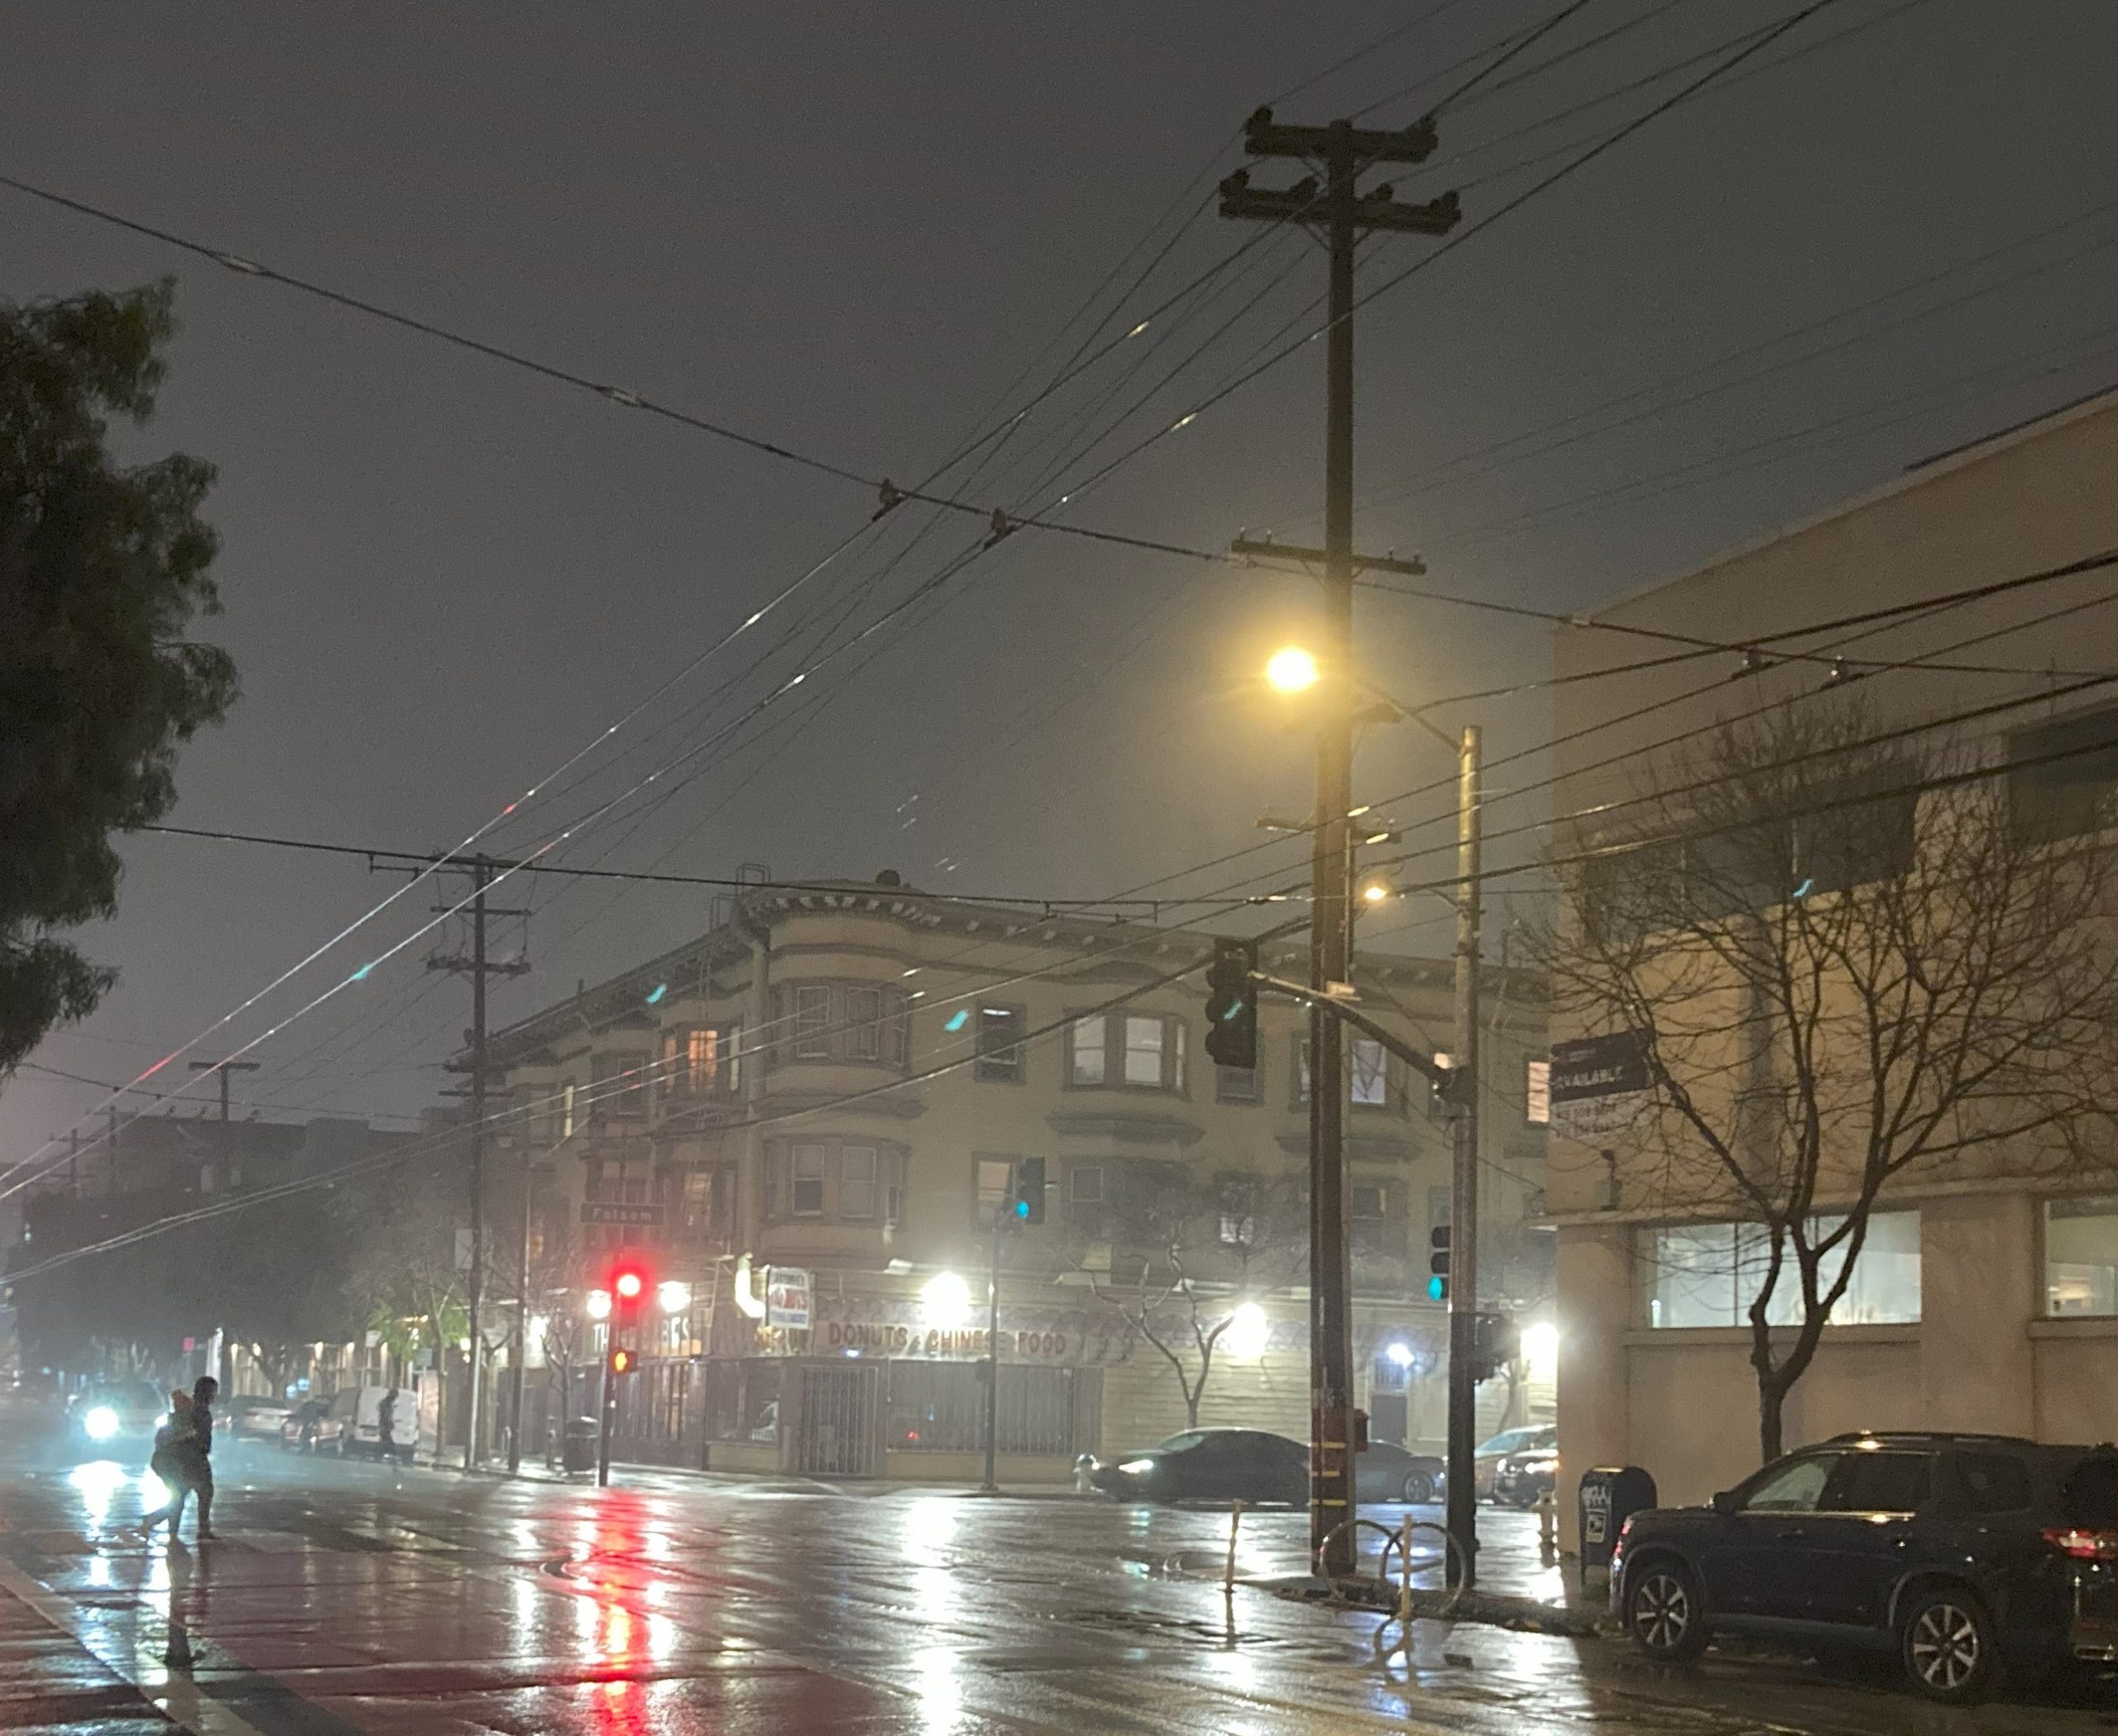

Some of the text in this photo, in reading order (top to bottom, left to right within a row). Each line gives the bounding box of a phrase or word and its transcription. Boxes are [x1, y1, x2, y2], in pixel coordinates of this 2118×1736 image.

[1551, 1065, 1622, 1090] AVAILABLE
[592, 1208, 652, 1220] Folsom
[829, 1323, 908, 1345] DONUTS
[927, 1329, 1009, 1351] CHINESE
[1018, 1331, 1066, 1355] FOOD
